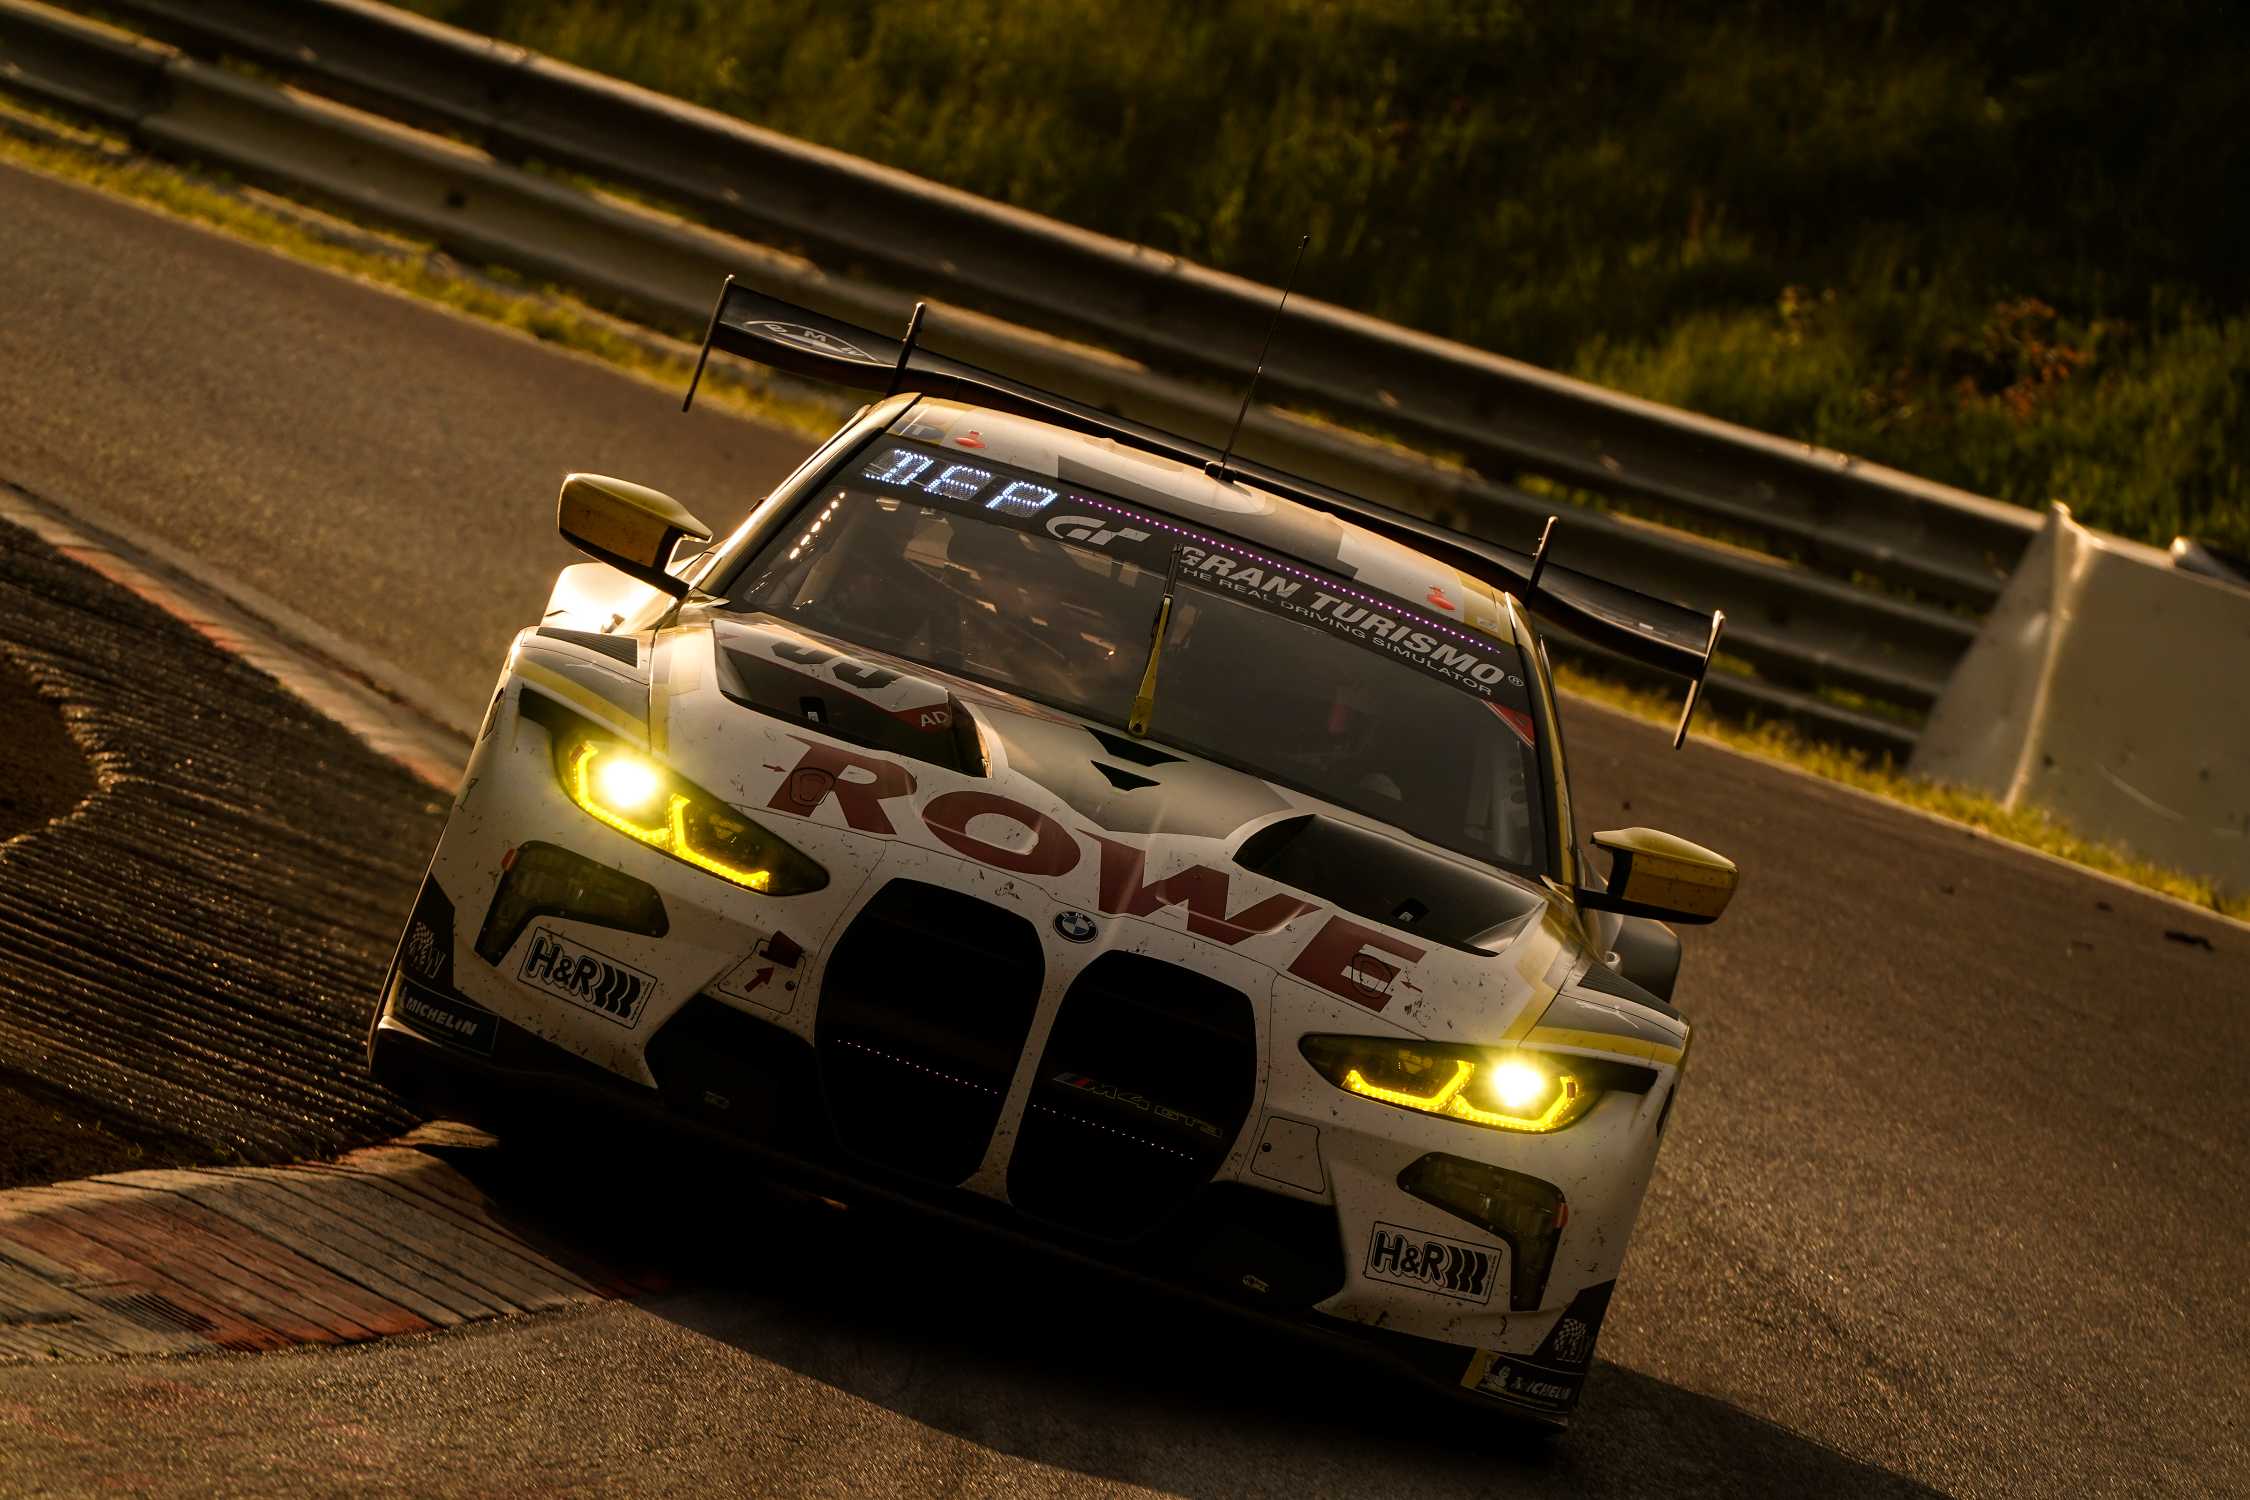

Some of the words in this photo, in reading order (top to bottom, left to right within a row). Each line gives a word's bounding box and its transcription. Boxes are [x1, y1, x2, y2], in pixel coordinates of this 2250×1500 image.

[1180, 545, 1303, 599] GRAN
[1219, 578, 1276, 604] REAL
[1280, 600, 1369, 640] DRIVING
[1372, 635, 1492, 697] SIMULATOR
[766, 734, 1428, 1014] ROWE
[526, 936, 601, 1001] H&R
[406, 996, 479, 1038] MICHELIN
[1372, 1231, 1449, 1287] H&R
